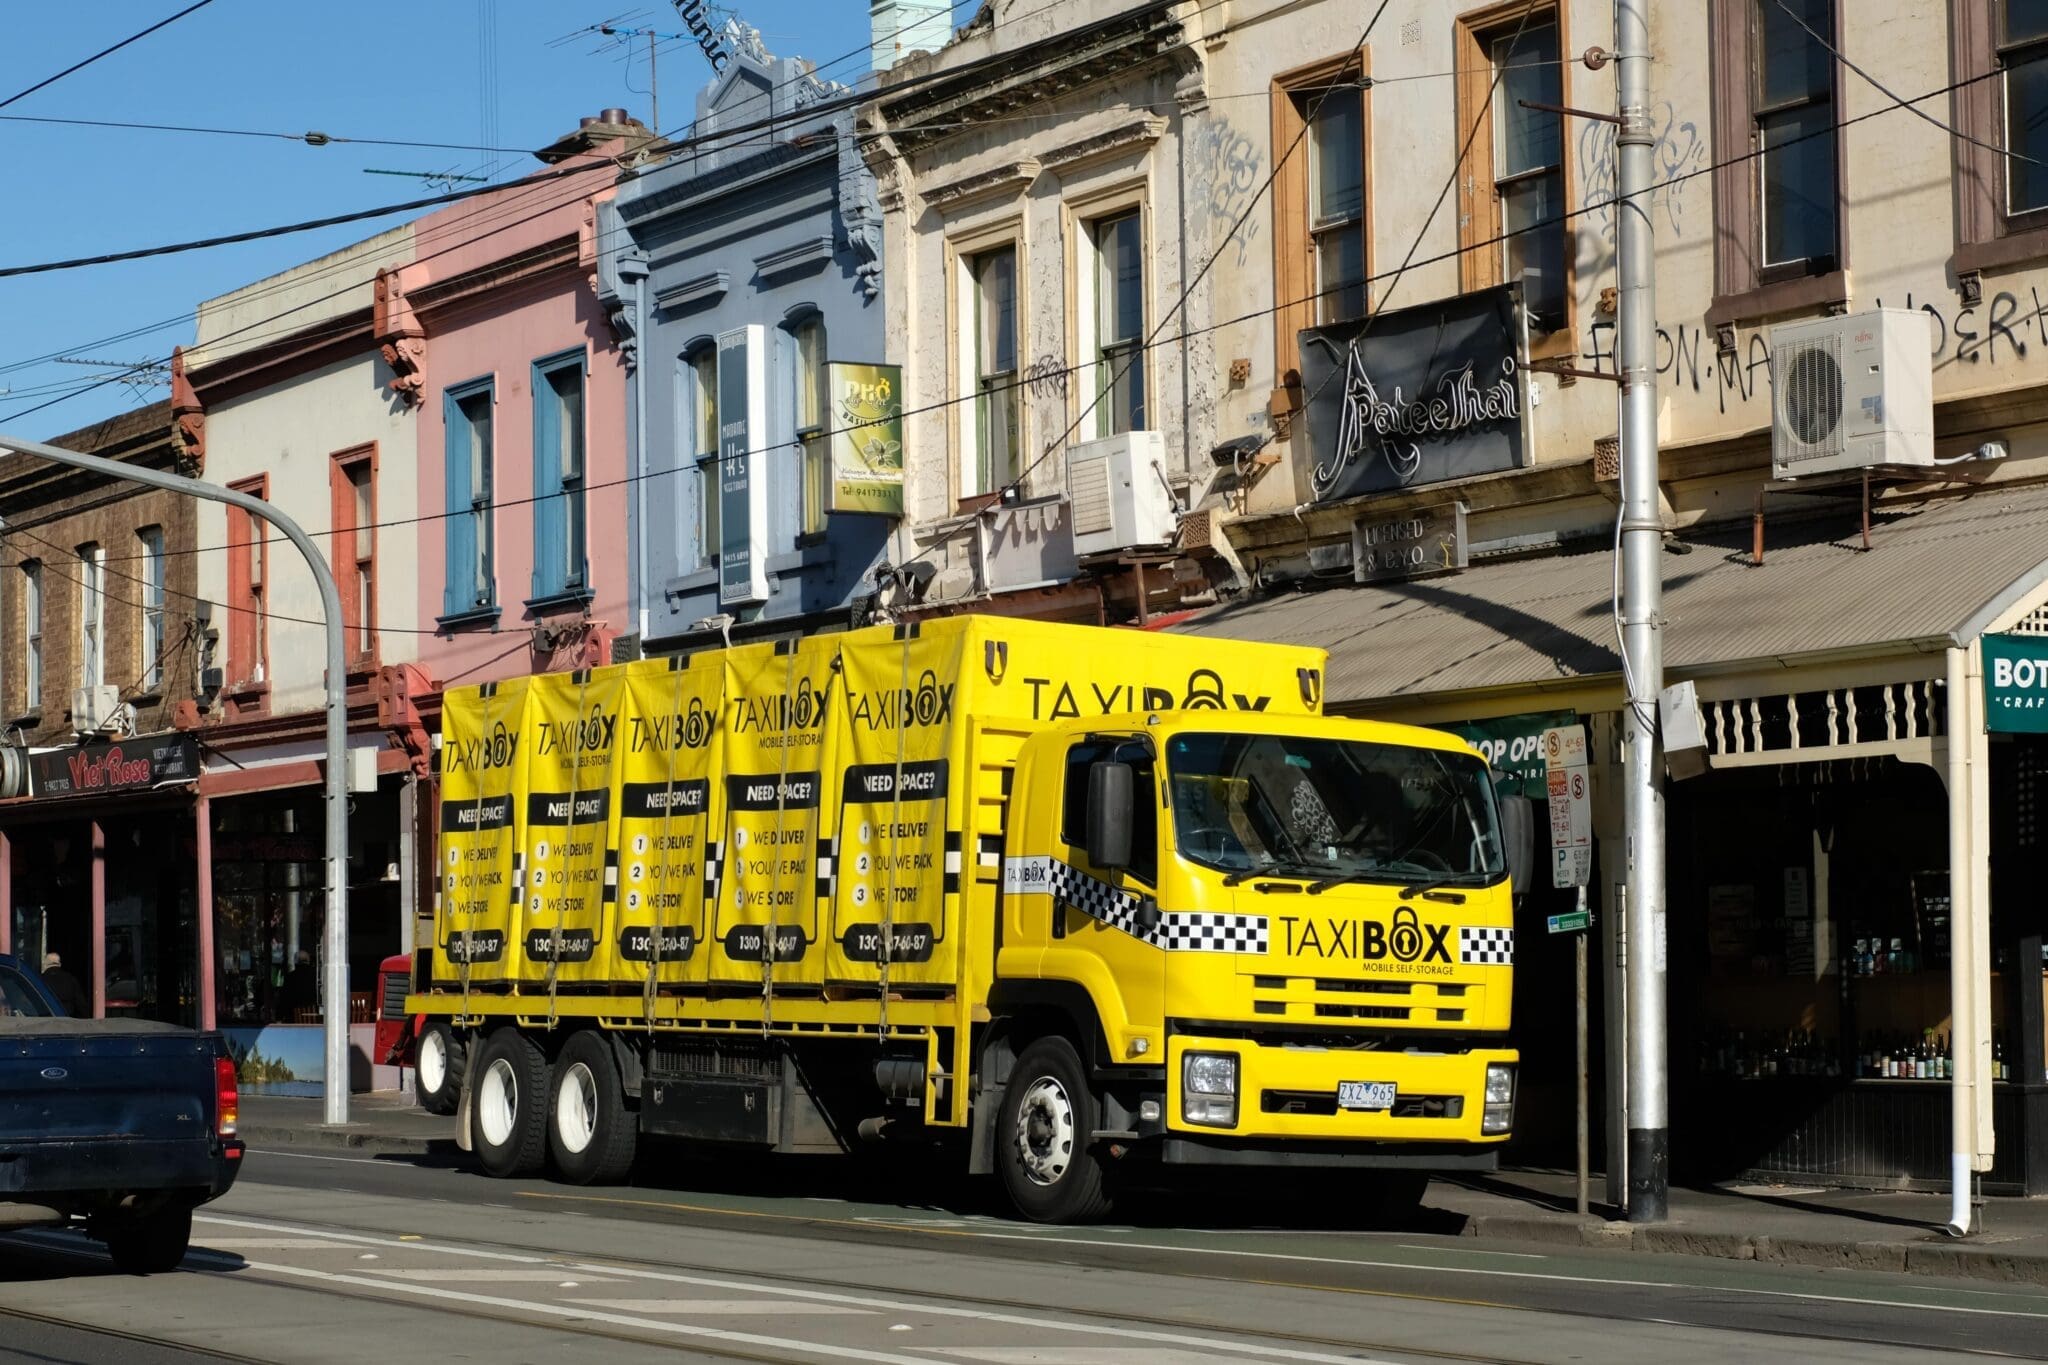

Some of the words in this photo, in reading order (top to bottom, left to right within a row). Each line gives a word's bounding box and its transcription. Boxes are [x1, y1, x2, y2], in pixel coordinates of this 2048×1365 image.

[1366, 519, 1423, 546] LICENSED
[1994, 658, 2048, 689] BOT
[734, 677, 829, 733] TAXIBOX
[67, 750, 105, 789] Viet
[106, 747, 151, 786] Rose
[863, 775, 892, 792] NEED
[672, 790, 702, 806] SPACE?
[747, 786, 774, 801] NEED
[548, 802, 568, 816] NEE
[738, 833, 742, 844] 1
[754, 832, 768, 844] WE
[771, 830, 804, 845] DLIVER
[863, 827, 867, 838] 1
[638, 839, 642, 850] 1
[667, 836, 693, 849] DELIVE
[540, 846, 544, 856] 1
[861, 857, 867, 869] 2
[1558, 849, 1566, 869] P
[536, 872, 542, 882] 2
[633, 867, 640, 877] 2
[1008, 861, 1046, 882] TAXBOX
[630, 895, 636, 905] 3
[662, 894, 682, 907] STOR
[747, 891, 763, 905] WE
[767, 891, 794, 905] SORE
[857, 889, 864, 901] 3
[891, 887, 917, 902] TORE
[533, 899, 538, 909] 3
[1279, 906, 1453, 964] TAXIBOX
[1363, 963, 1394, 973] MOBILE
[1396, 964, 1454, 976] SELF-STORAGE
[1341, 1084, 1363, 1100] ZXZ
[1372, 1086, 1393, 1101] 965
